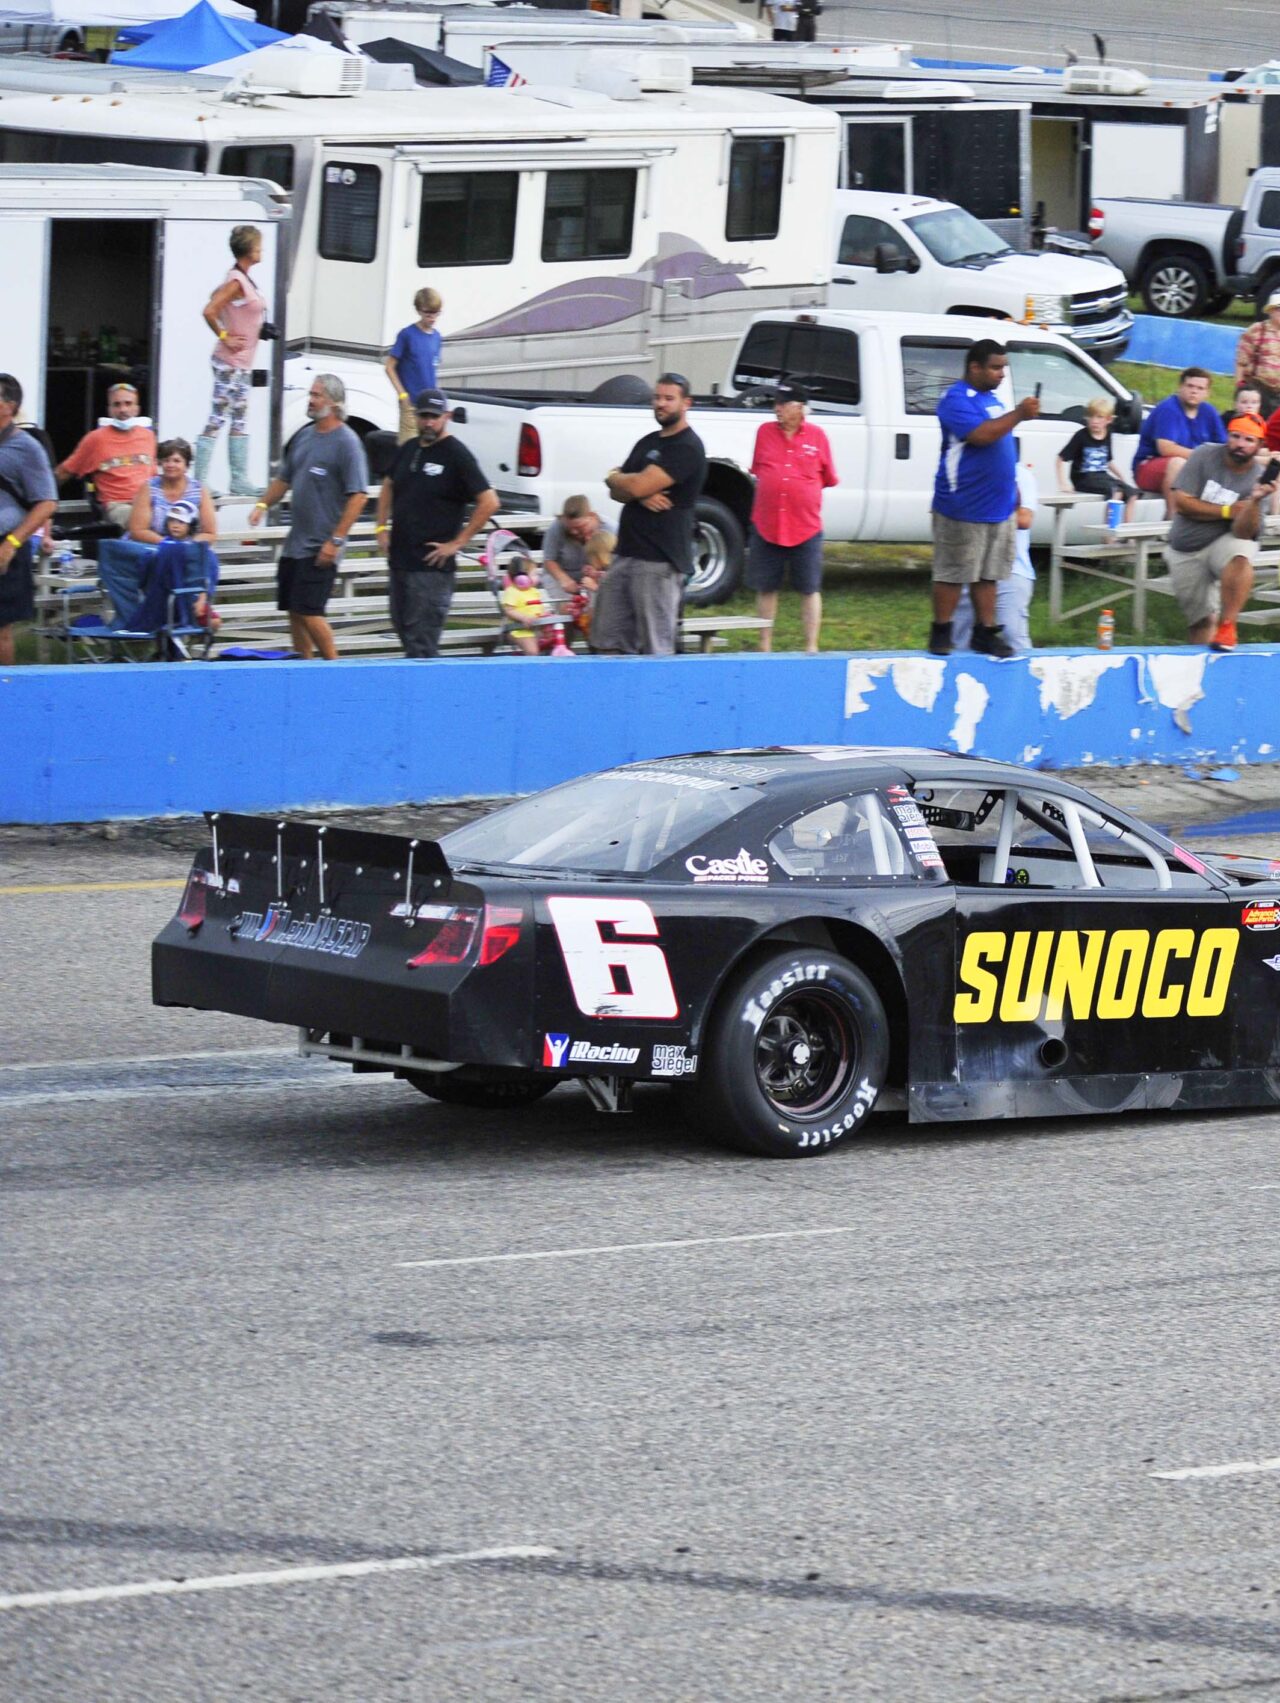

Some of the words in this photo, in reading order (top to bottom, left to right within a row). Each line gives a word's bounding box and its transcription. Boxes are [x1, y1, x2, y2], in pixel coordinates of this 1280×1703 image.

[685, 848, 769, 876] Castle
[546, 896, 680, 1020] 6
[953, 928, 1240, 1023] SUNOCO
[569, 1040, 641, 1064] iRacing
[652, 1044, 687, 1058] max
